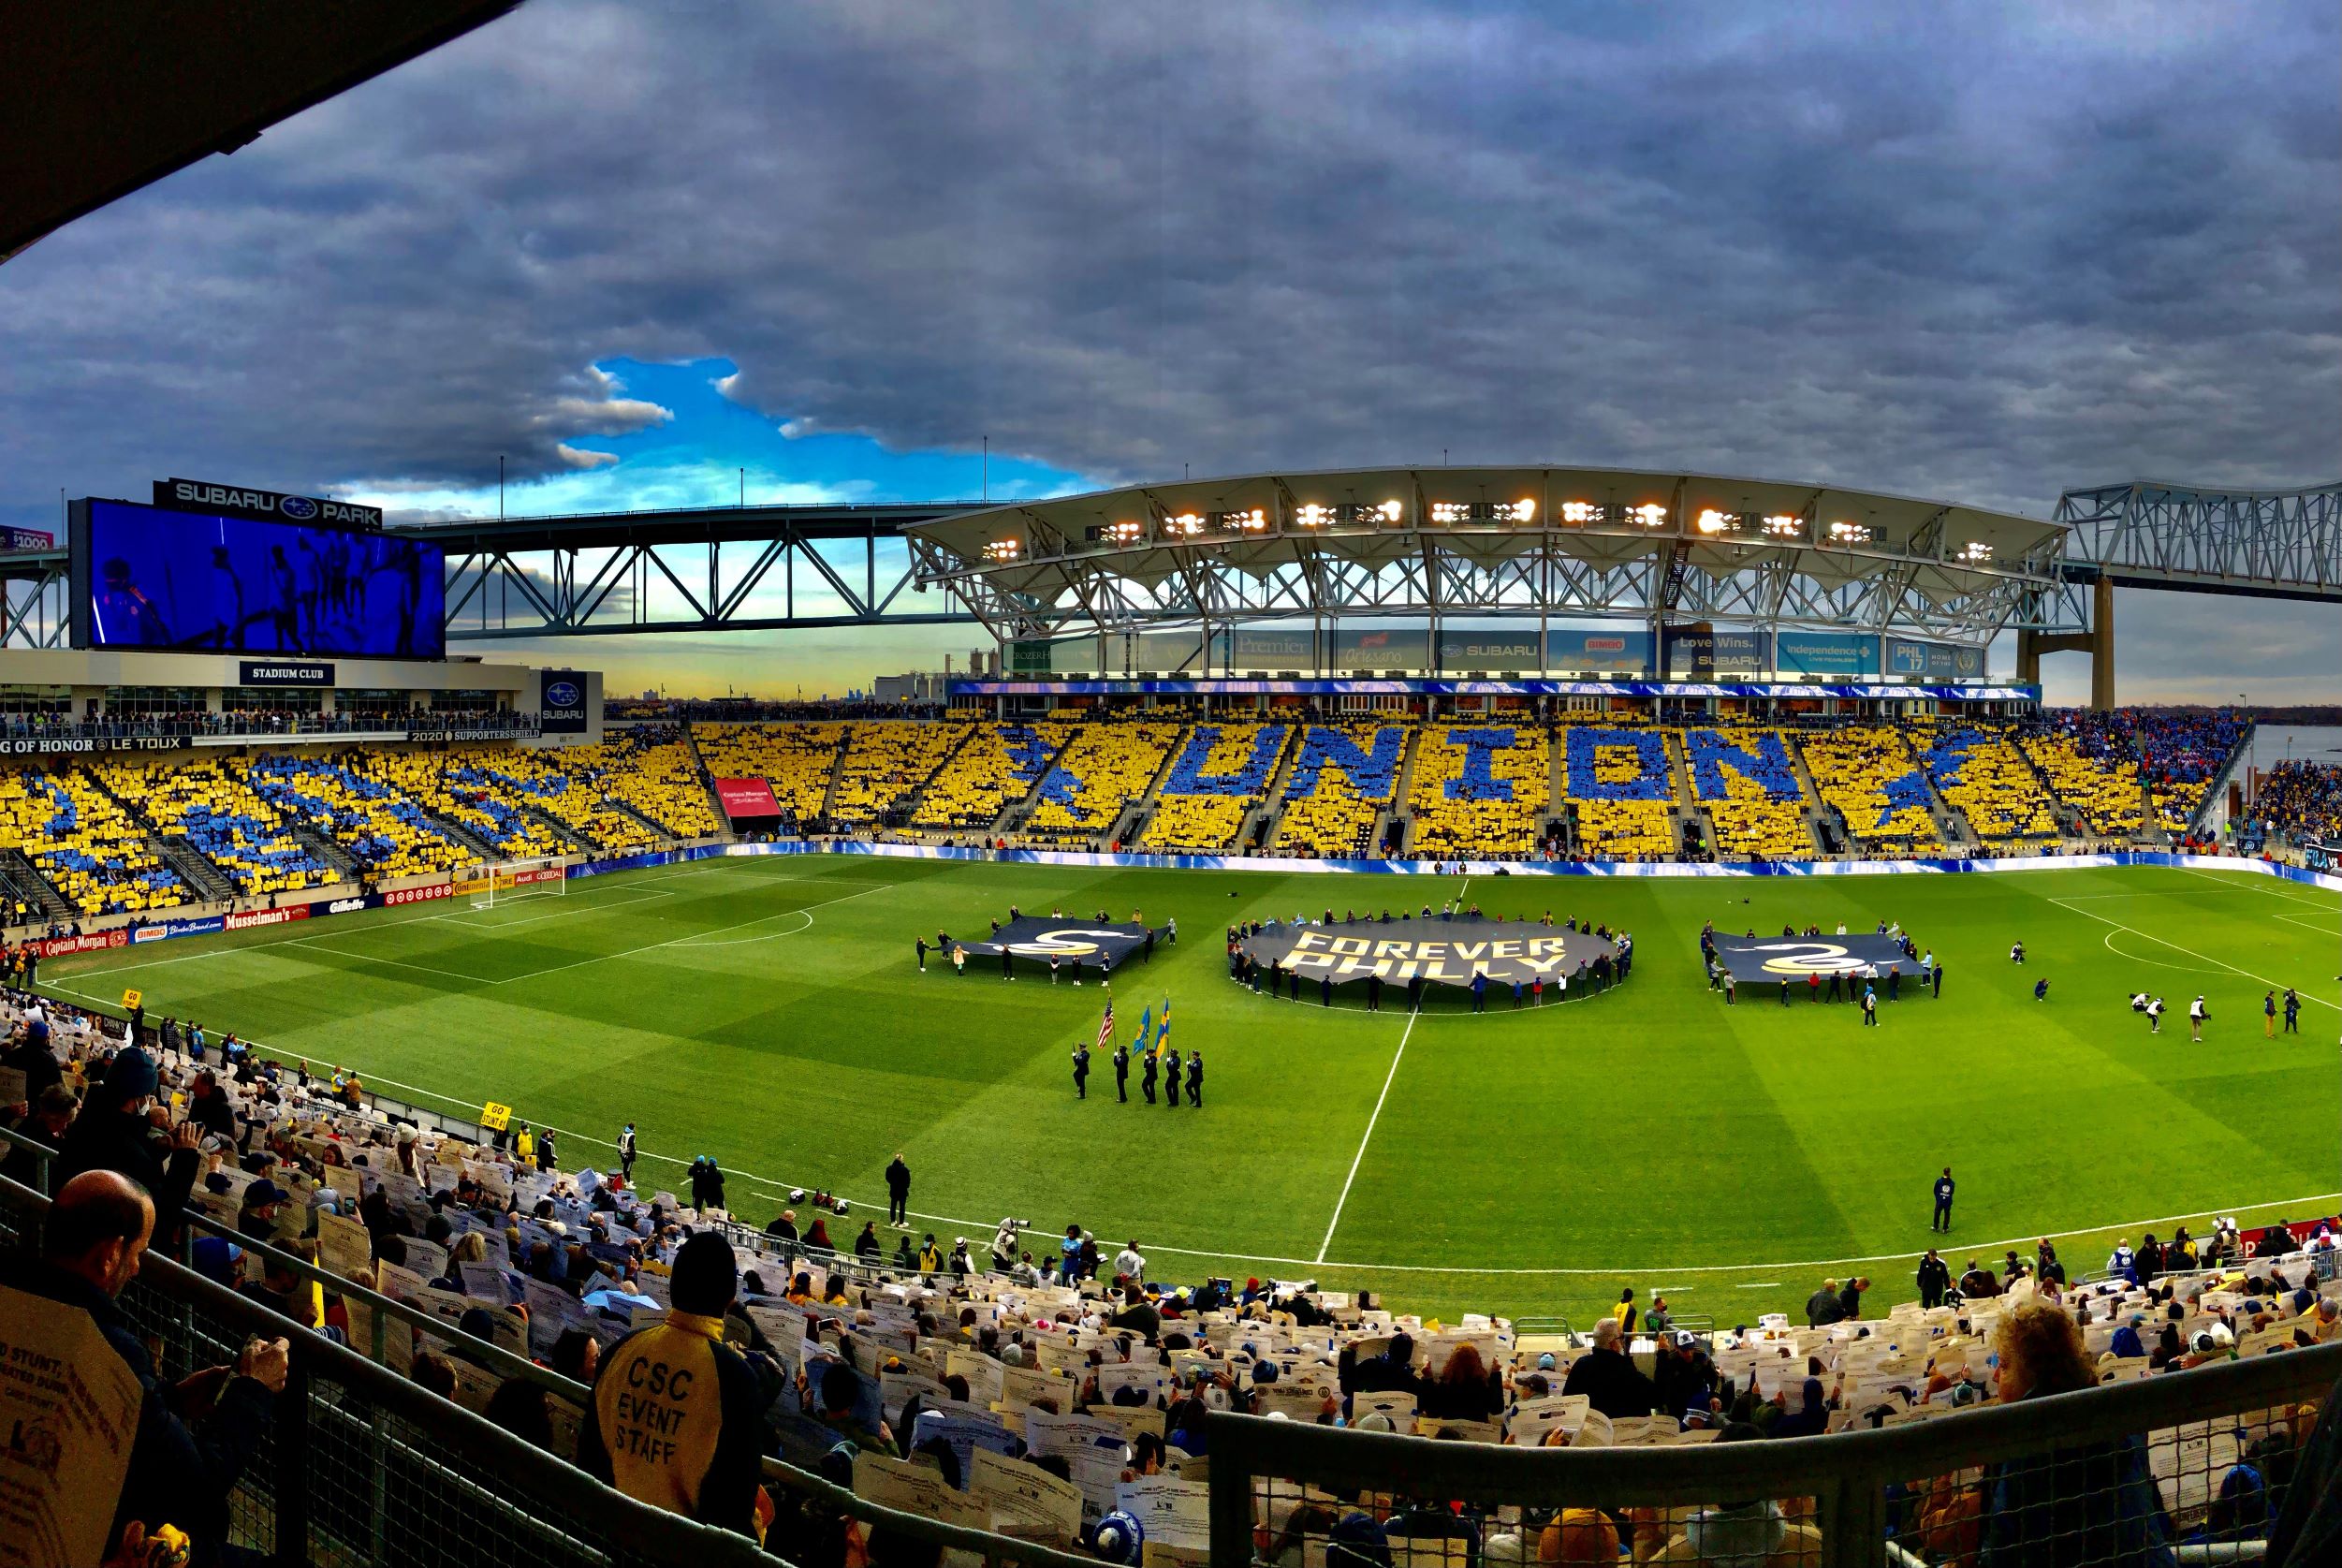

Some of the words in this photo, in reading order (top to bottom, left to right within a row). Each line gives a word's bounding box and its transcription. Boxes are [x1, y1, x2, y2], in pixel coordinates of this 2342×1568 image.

[175, 483, 274, 511] SUBARU
[323, 504, 379, 526] PARK
[1237, 637, 1308, 653] Premier
[1588, 640, 1623, 650] BIMBO
[1679, 637, 1713, 648] Love
[1716, 637, 1754, 648] Wins.
[1466, 645, 1537, 657] SUBARU
[1787, 644, 1857, 657] Independence
[1896, 645, 1923, 658] PHL
[1698, 655, 1762, 666] SUBARU
[1910, 658, 1923, 671] 17
[253, 668, 298, 678] STADIUM
[299, 669, 324, 679] CLUB
[542, 710, 584, 720] SUBARU
[412, 731, 444, 742] 2020
[14, 740, 36, 753] OF
[39, 740, 94, 753] HONOR
[111, 739, 132, 750] LE
[136, 738, 181, 749] TOUX
[516, 873, 533, 884] Audi
[329, 899, 365, 914] Gillette
[226, 907, 290, 930] Musselman's
[137, 928, 166, 939] BIMBO
[46, 937, 76, 957] Captain
[76, 935, 107, 952] Morgan
[1294, 931, 1566, 960] FOREVER
[1279, 950, 1567, 979] PHILLY
[128, 992, 138, 1001] GO
[491, 1106, 504, 1114] GO
[481, 1114, 499, 1125] STUNT
[627, 1357, 693, 1401] CSC
[618, 1392, 686, 1437] EVENT
[615, 1425, 677, 1465] STAFF
